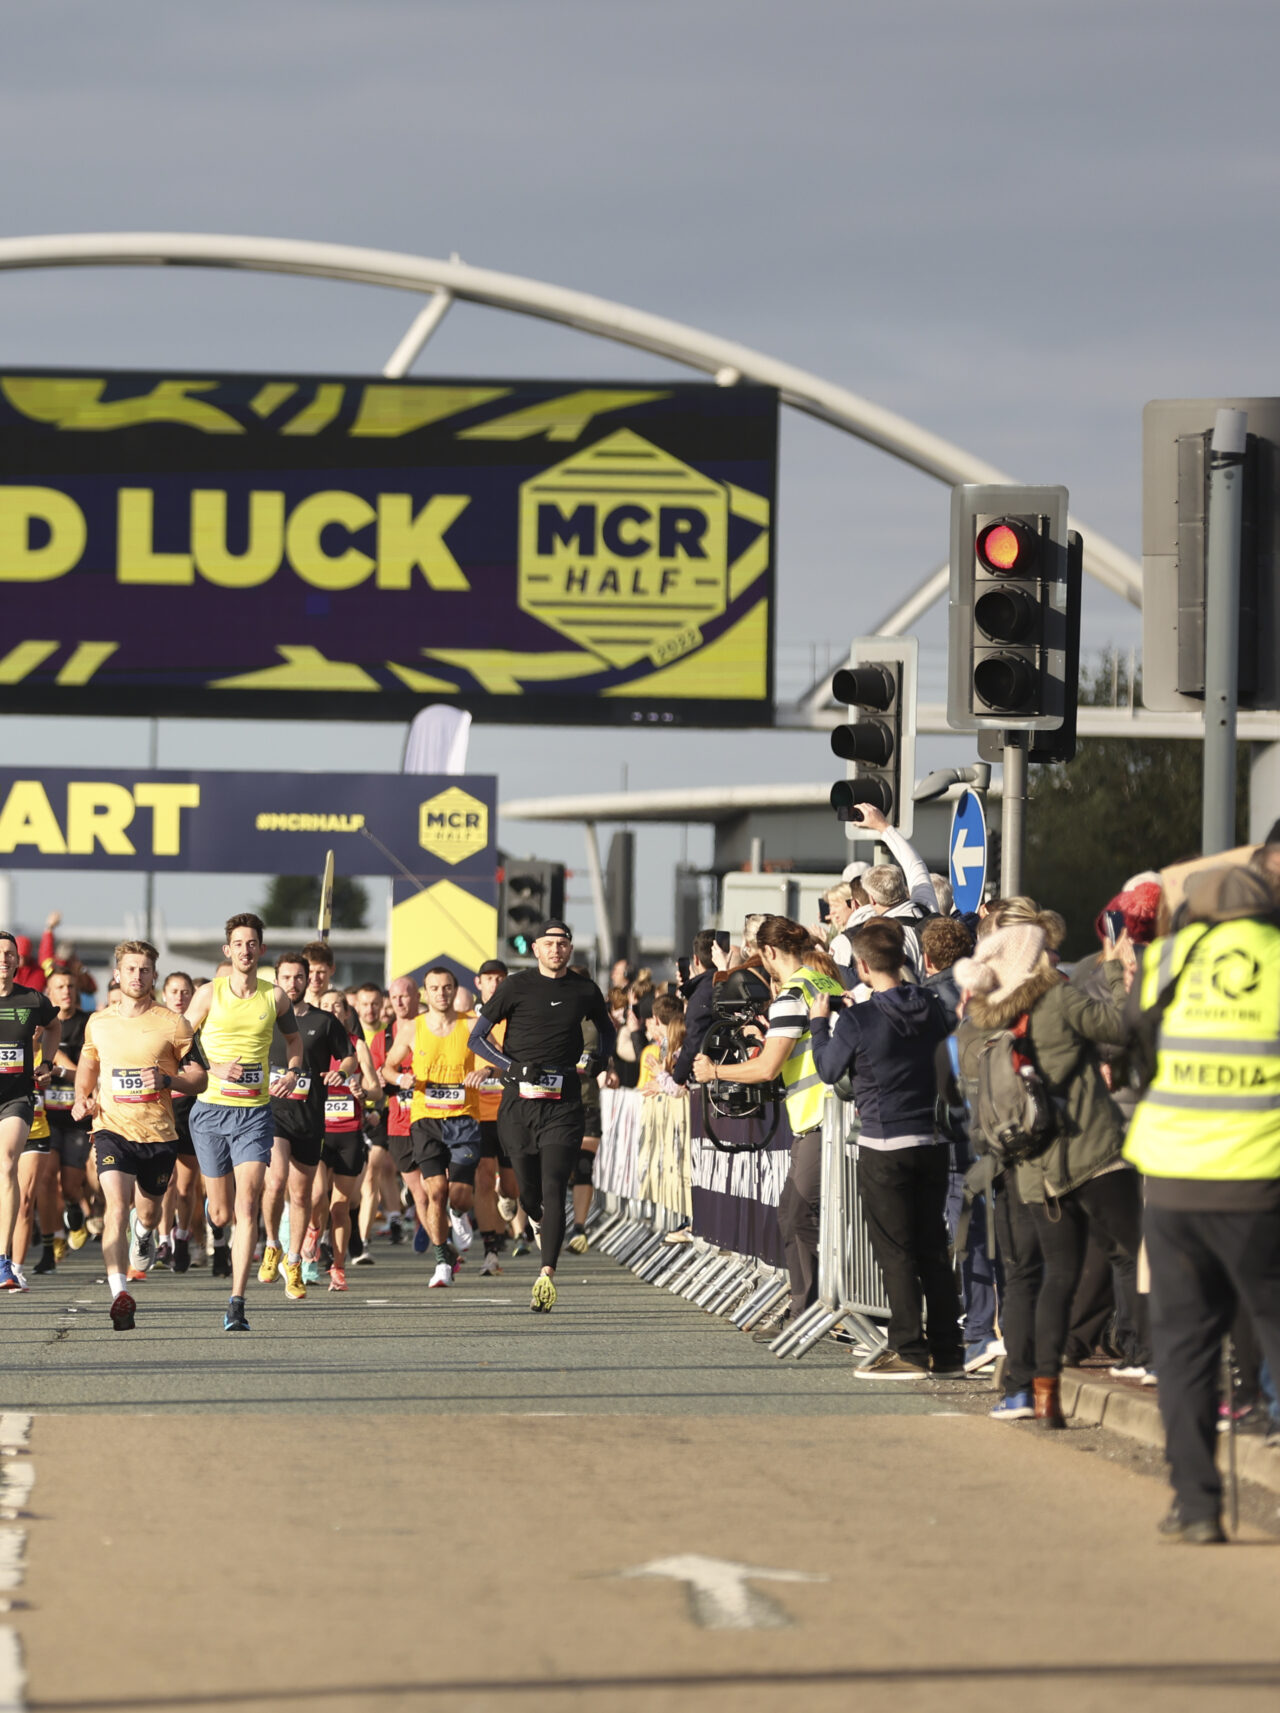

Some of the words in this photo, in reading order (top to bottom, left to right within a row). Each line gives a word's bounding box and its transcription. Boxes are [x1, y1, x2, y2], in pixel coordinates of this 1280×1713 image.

[116, 486, 472, 592] LUCK
[536, 502, 711, 560] MCR
[564, 566, 683, 596] HALF
[656, 628, 698, 660] 2022
[255, 813, 365, 833] #MCRHALF
[426, 812, 481, 829] MCR
[1173, 1063, 1266, 1088] MEDIA
[430, 1090, 460, 1099] 2929
